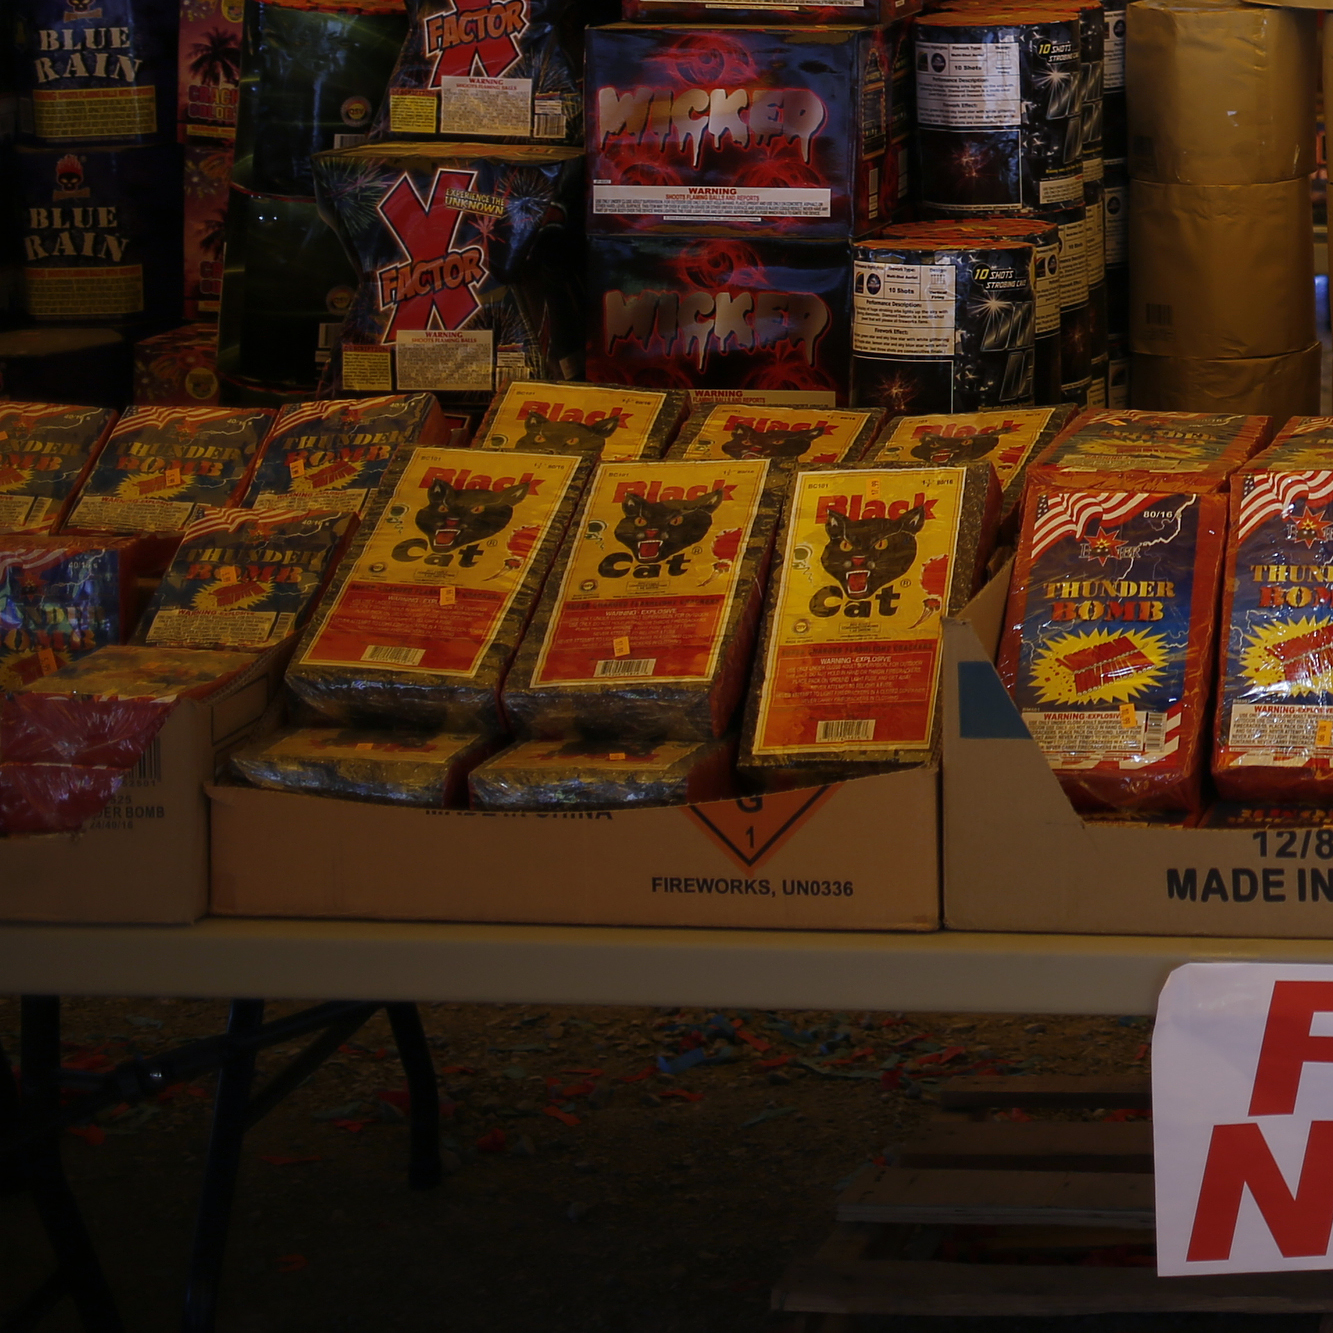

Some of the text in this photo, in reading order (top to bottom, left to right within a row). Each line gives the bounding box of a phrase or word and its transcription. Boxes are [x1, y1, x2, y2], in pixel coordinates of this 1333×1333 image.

[38, 27, 131, 51] BLUE
[427, 2, 525, 54] FACTOR
[1039, 44, 1072, 55] 10 SHOTS
[32, 53, 144, 84] RAIN
[688, 187, 737, 195] WARNING
[445, 196, 505, 215] UNKNOWN
[28, 206, 119, 230] BLUE
[23, 231, 131, 263] RAIN
[379, 247, 488, 309] FACTOR
[974, 269, 1014, 280] 10 SHOTS
[612, 479, 739, 504] Black
[816, 492, 938, 524] Black
[1143, 511, 1172, 519] 80/16
[391, 538, 483, 567] Cat
[598, 550, 692, 579] Cat
[1042, 580, 1176, 599] THUNDER
[808, 585, 900, 619] Cat
[1050, 601, 1164, 622] BOMB
[125, 806, 165, 818] BOMB
[745, 826, 755, 848] 1
[651, 877, 854, 897] FIREWORKS, UN0336
[1167, 868, 1284, 903] MADE
